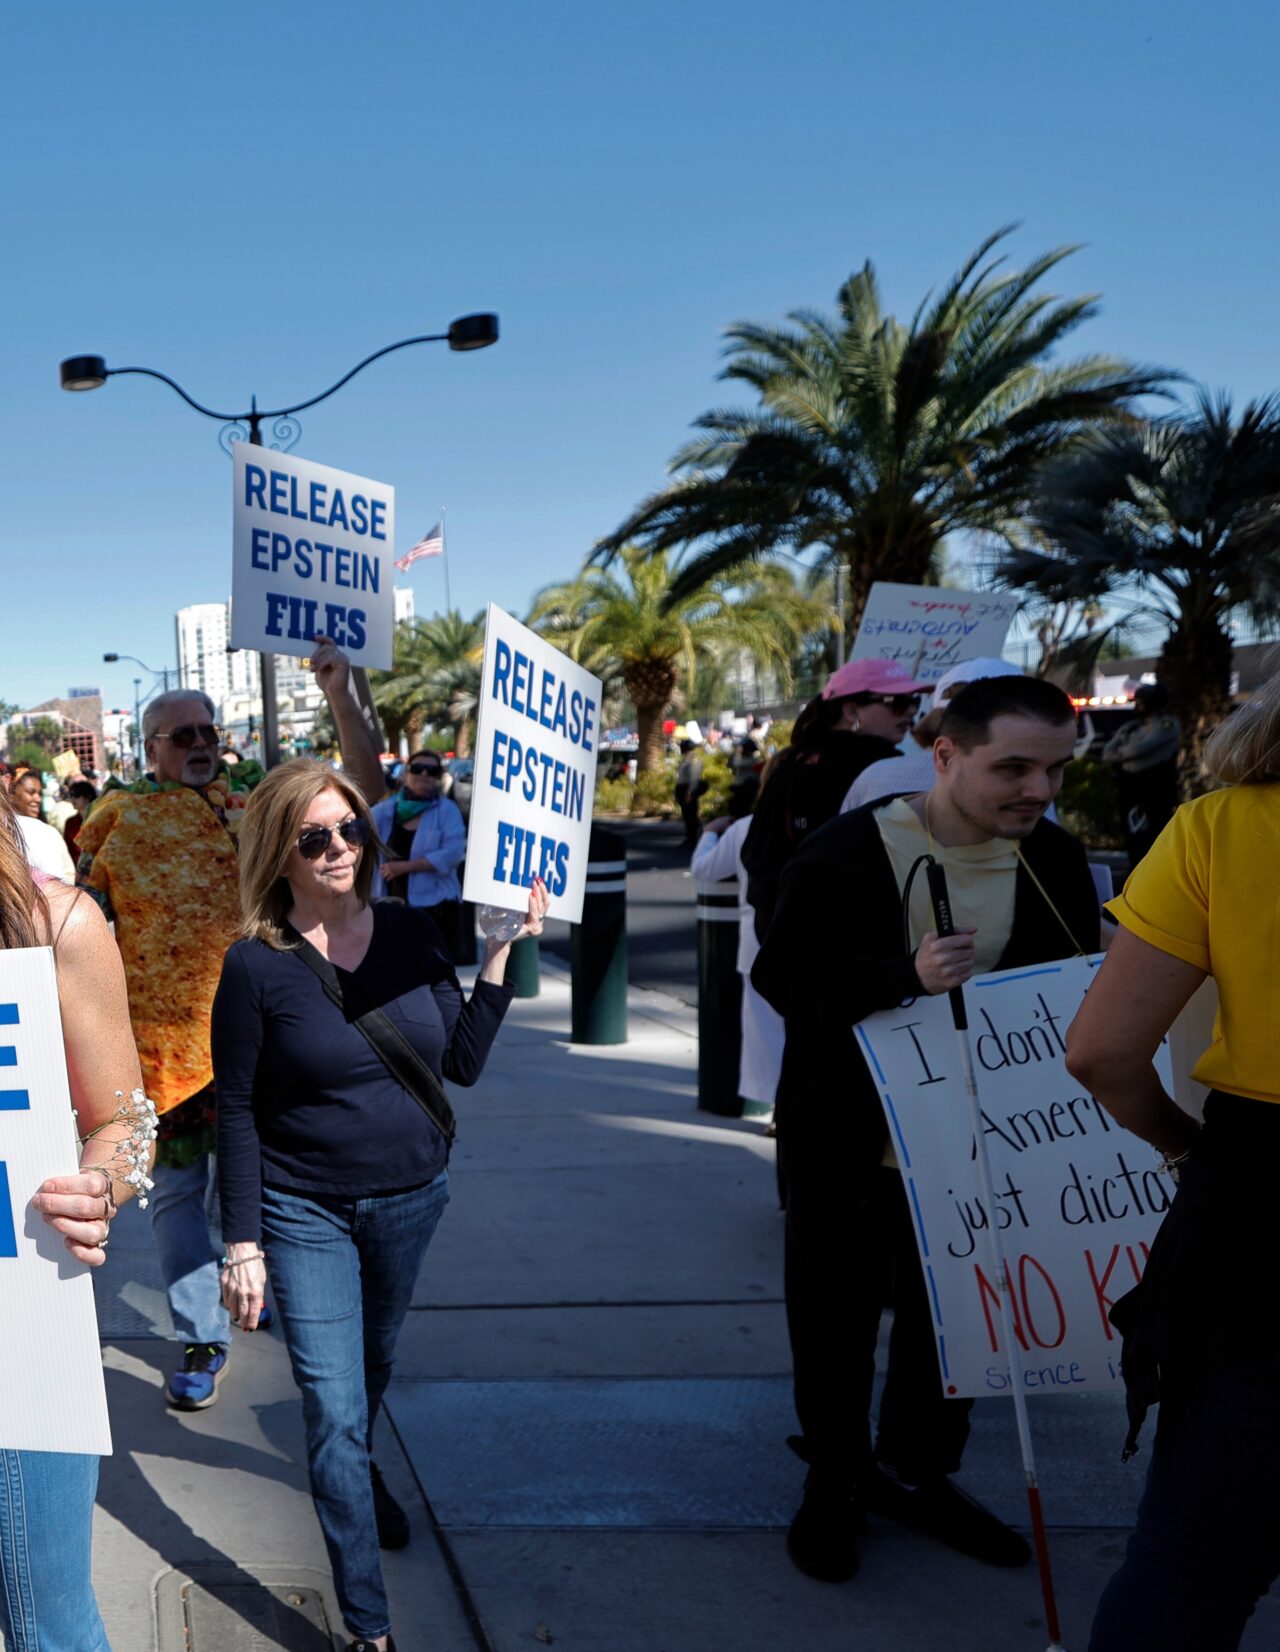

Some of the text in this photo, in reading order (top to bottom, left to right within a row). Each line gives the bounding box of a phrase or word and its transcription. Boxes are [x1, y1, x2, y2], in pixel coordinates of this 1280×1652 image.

[245, 463, 386, 541] RELEASE
[252, 527, 380, 593] EPSTEIN
[265, 592, 366, 650] FILES
[492, 638, 596, 752] RELEASE
[490, 729, 586, 822] EPSTEIN
[493, 820, 570, 897] FILES
[891, 992, 1067, 1086] I don't
[971, 1096, 1126, 1161] Ameri
[947, 1172, 1030, 1258] just
[1060, 1153, 1179, 1225] dicta
[974, 1254, 1067, 1352] NO
